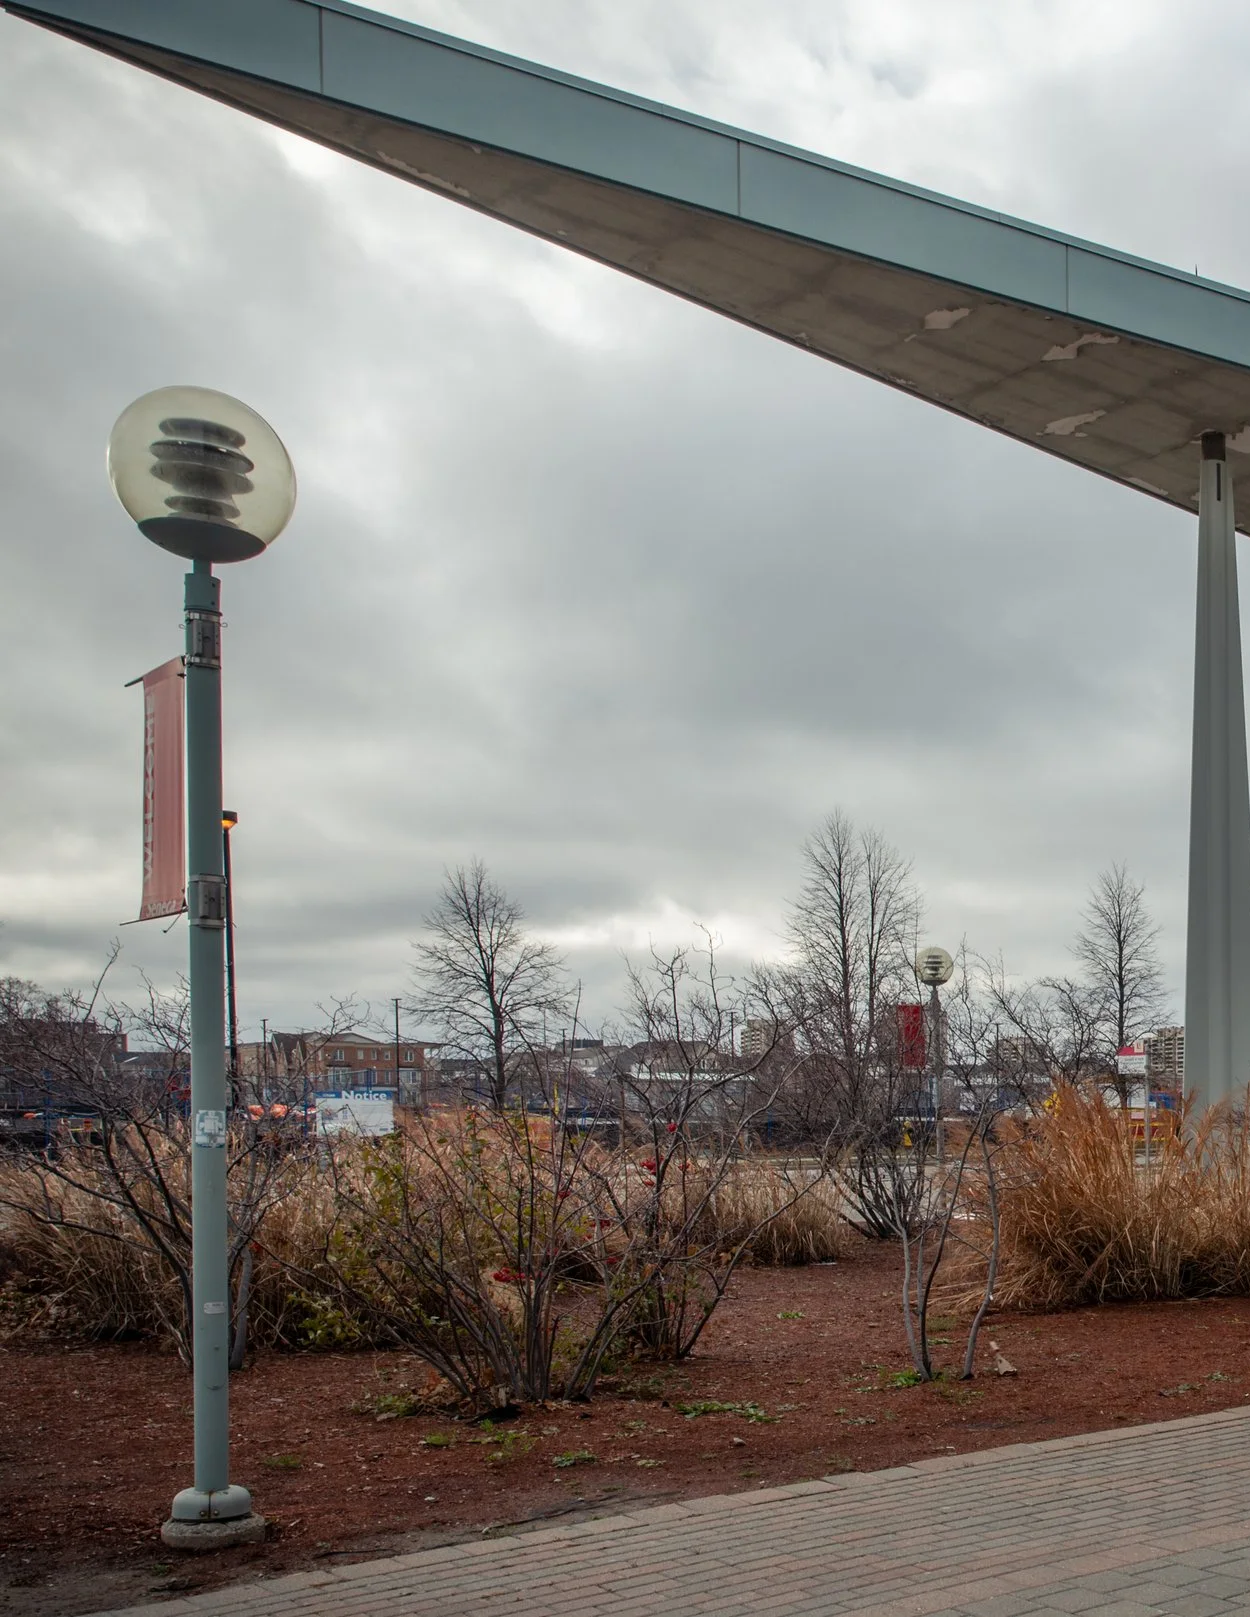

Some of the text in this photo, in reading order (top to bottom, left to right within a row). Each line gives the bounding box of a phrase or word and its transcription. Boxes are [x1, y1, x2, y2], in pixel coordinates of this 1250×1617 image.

[144, 693, 155, 881] WELCOME
[146, 900, 177, 918] Seneca
[341, 1090, 387, 1100] Notice
